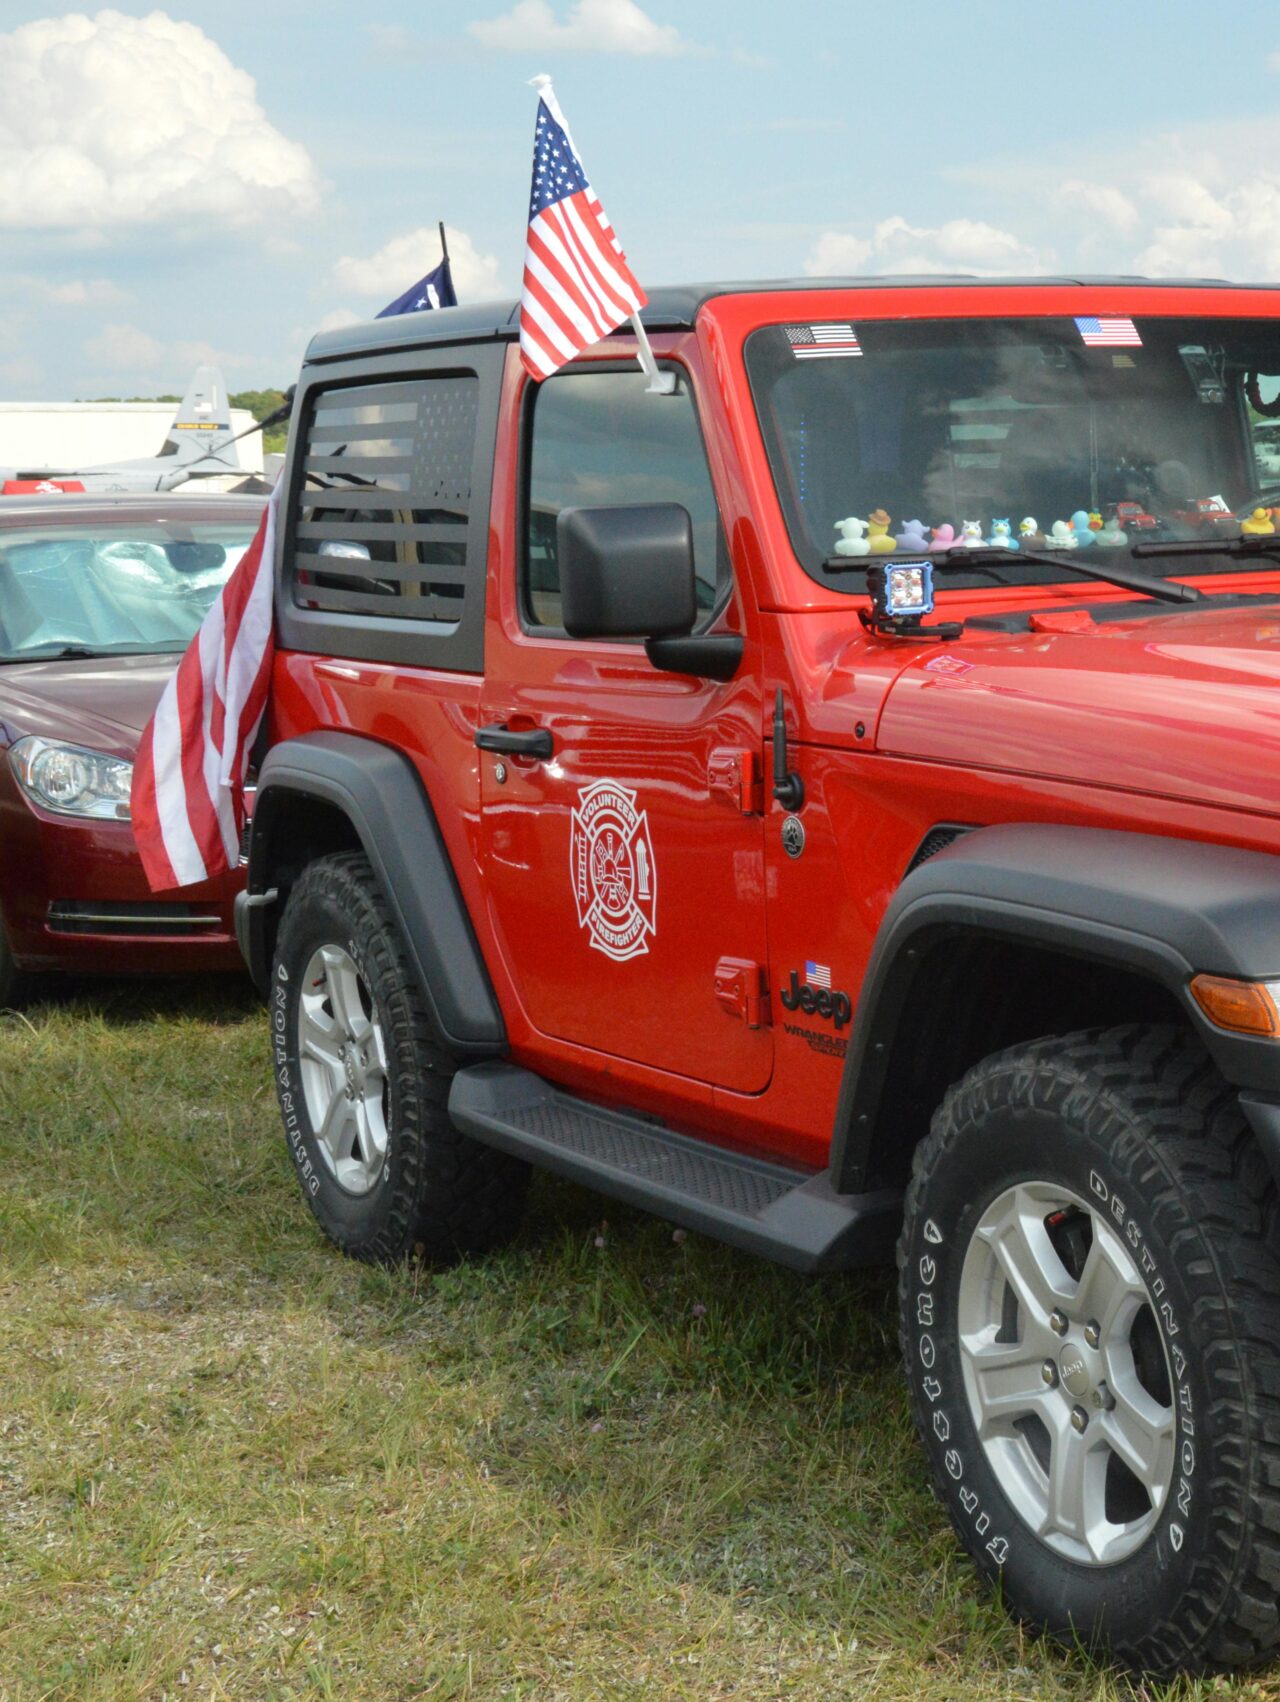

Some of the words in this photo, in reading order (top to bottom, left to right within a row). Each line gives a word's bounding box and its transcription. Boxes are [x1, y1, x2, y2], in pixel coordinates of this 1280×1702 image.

[582, 794, 637, 827] VOLUNTEER
[590, 910, 643, 947] FIREFIGHTER
[780, 970, 851, 1030] Jeep
[274, 985, 320, 1197] DESTINATION
[1089, 1169, 1197, 1518] DESTINATION
[1062, 1360, 1083, 1379] Jeep
